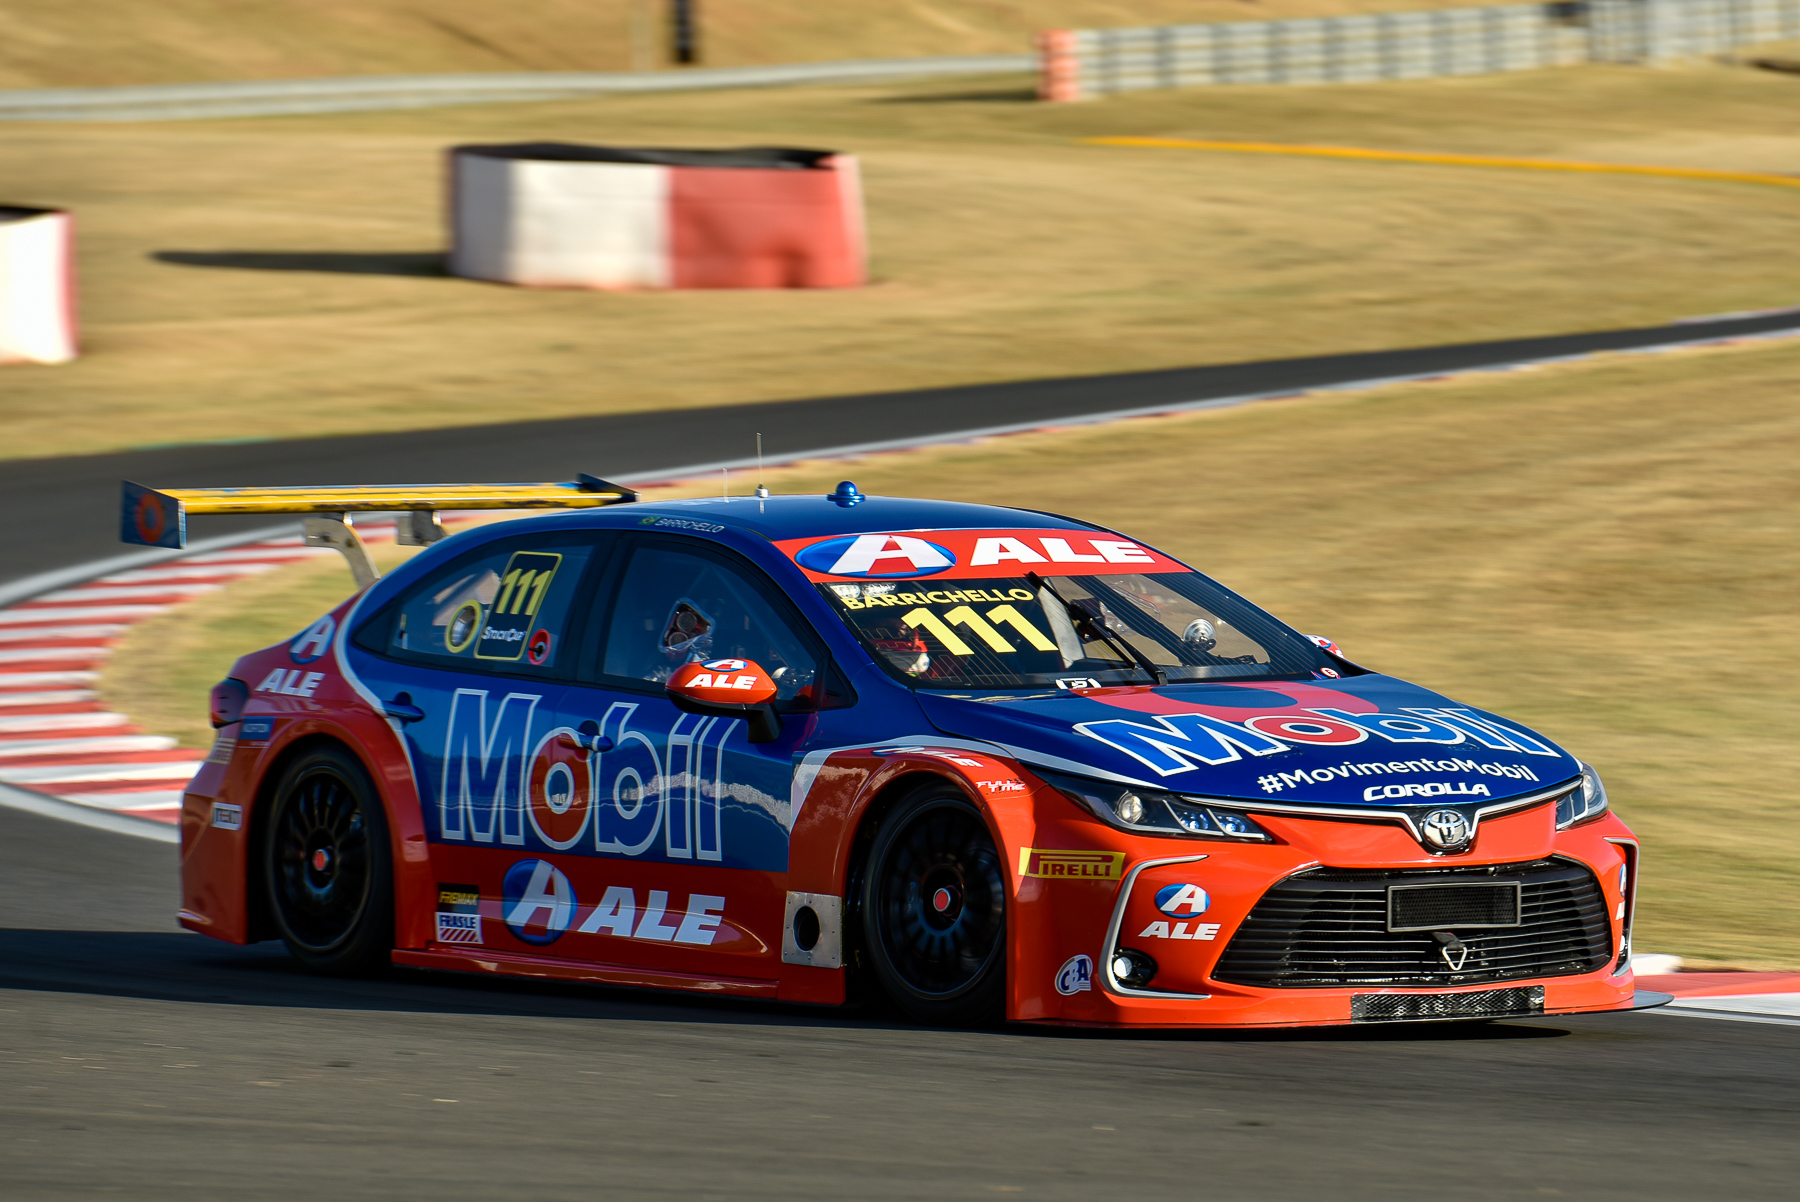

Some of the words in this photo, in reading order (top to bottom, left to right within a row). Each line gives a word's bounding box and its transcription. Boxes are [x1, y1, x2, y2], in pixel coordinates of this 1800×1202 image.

[655, 518, 724, 533] BARRICHELLO
[970, 537, 1156, 566] ALE
[495, 568, 552, 615] 111
[840, 588, 1035, 610] BARRICHELLO
[901, 604, 1059, 656] 111
[254, 668, 326, 697] ALE
[685, 674, 758, 690] ALE
[1072, 707, 1561, 777] Mobil
[440, 687, 741, 862] Mobil
[1257, 757, 1540, 794] #MovimentoMobil
[1363, 782, 1491, 801] COROLLA
[1028, 852, 1114, 877] PIRELLI
[577, 885, 726, 945] ALE
[1138, 920, 1222, 941] ALE
[1060, 958, 1090, 991] CBA
